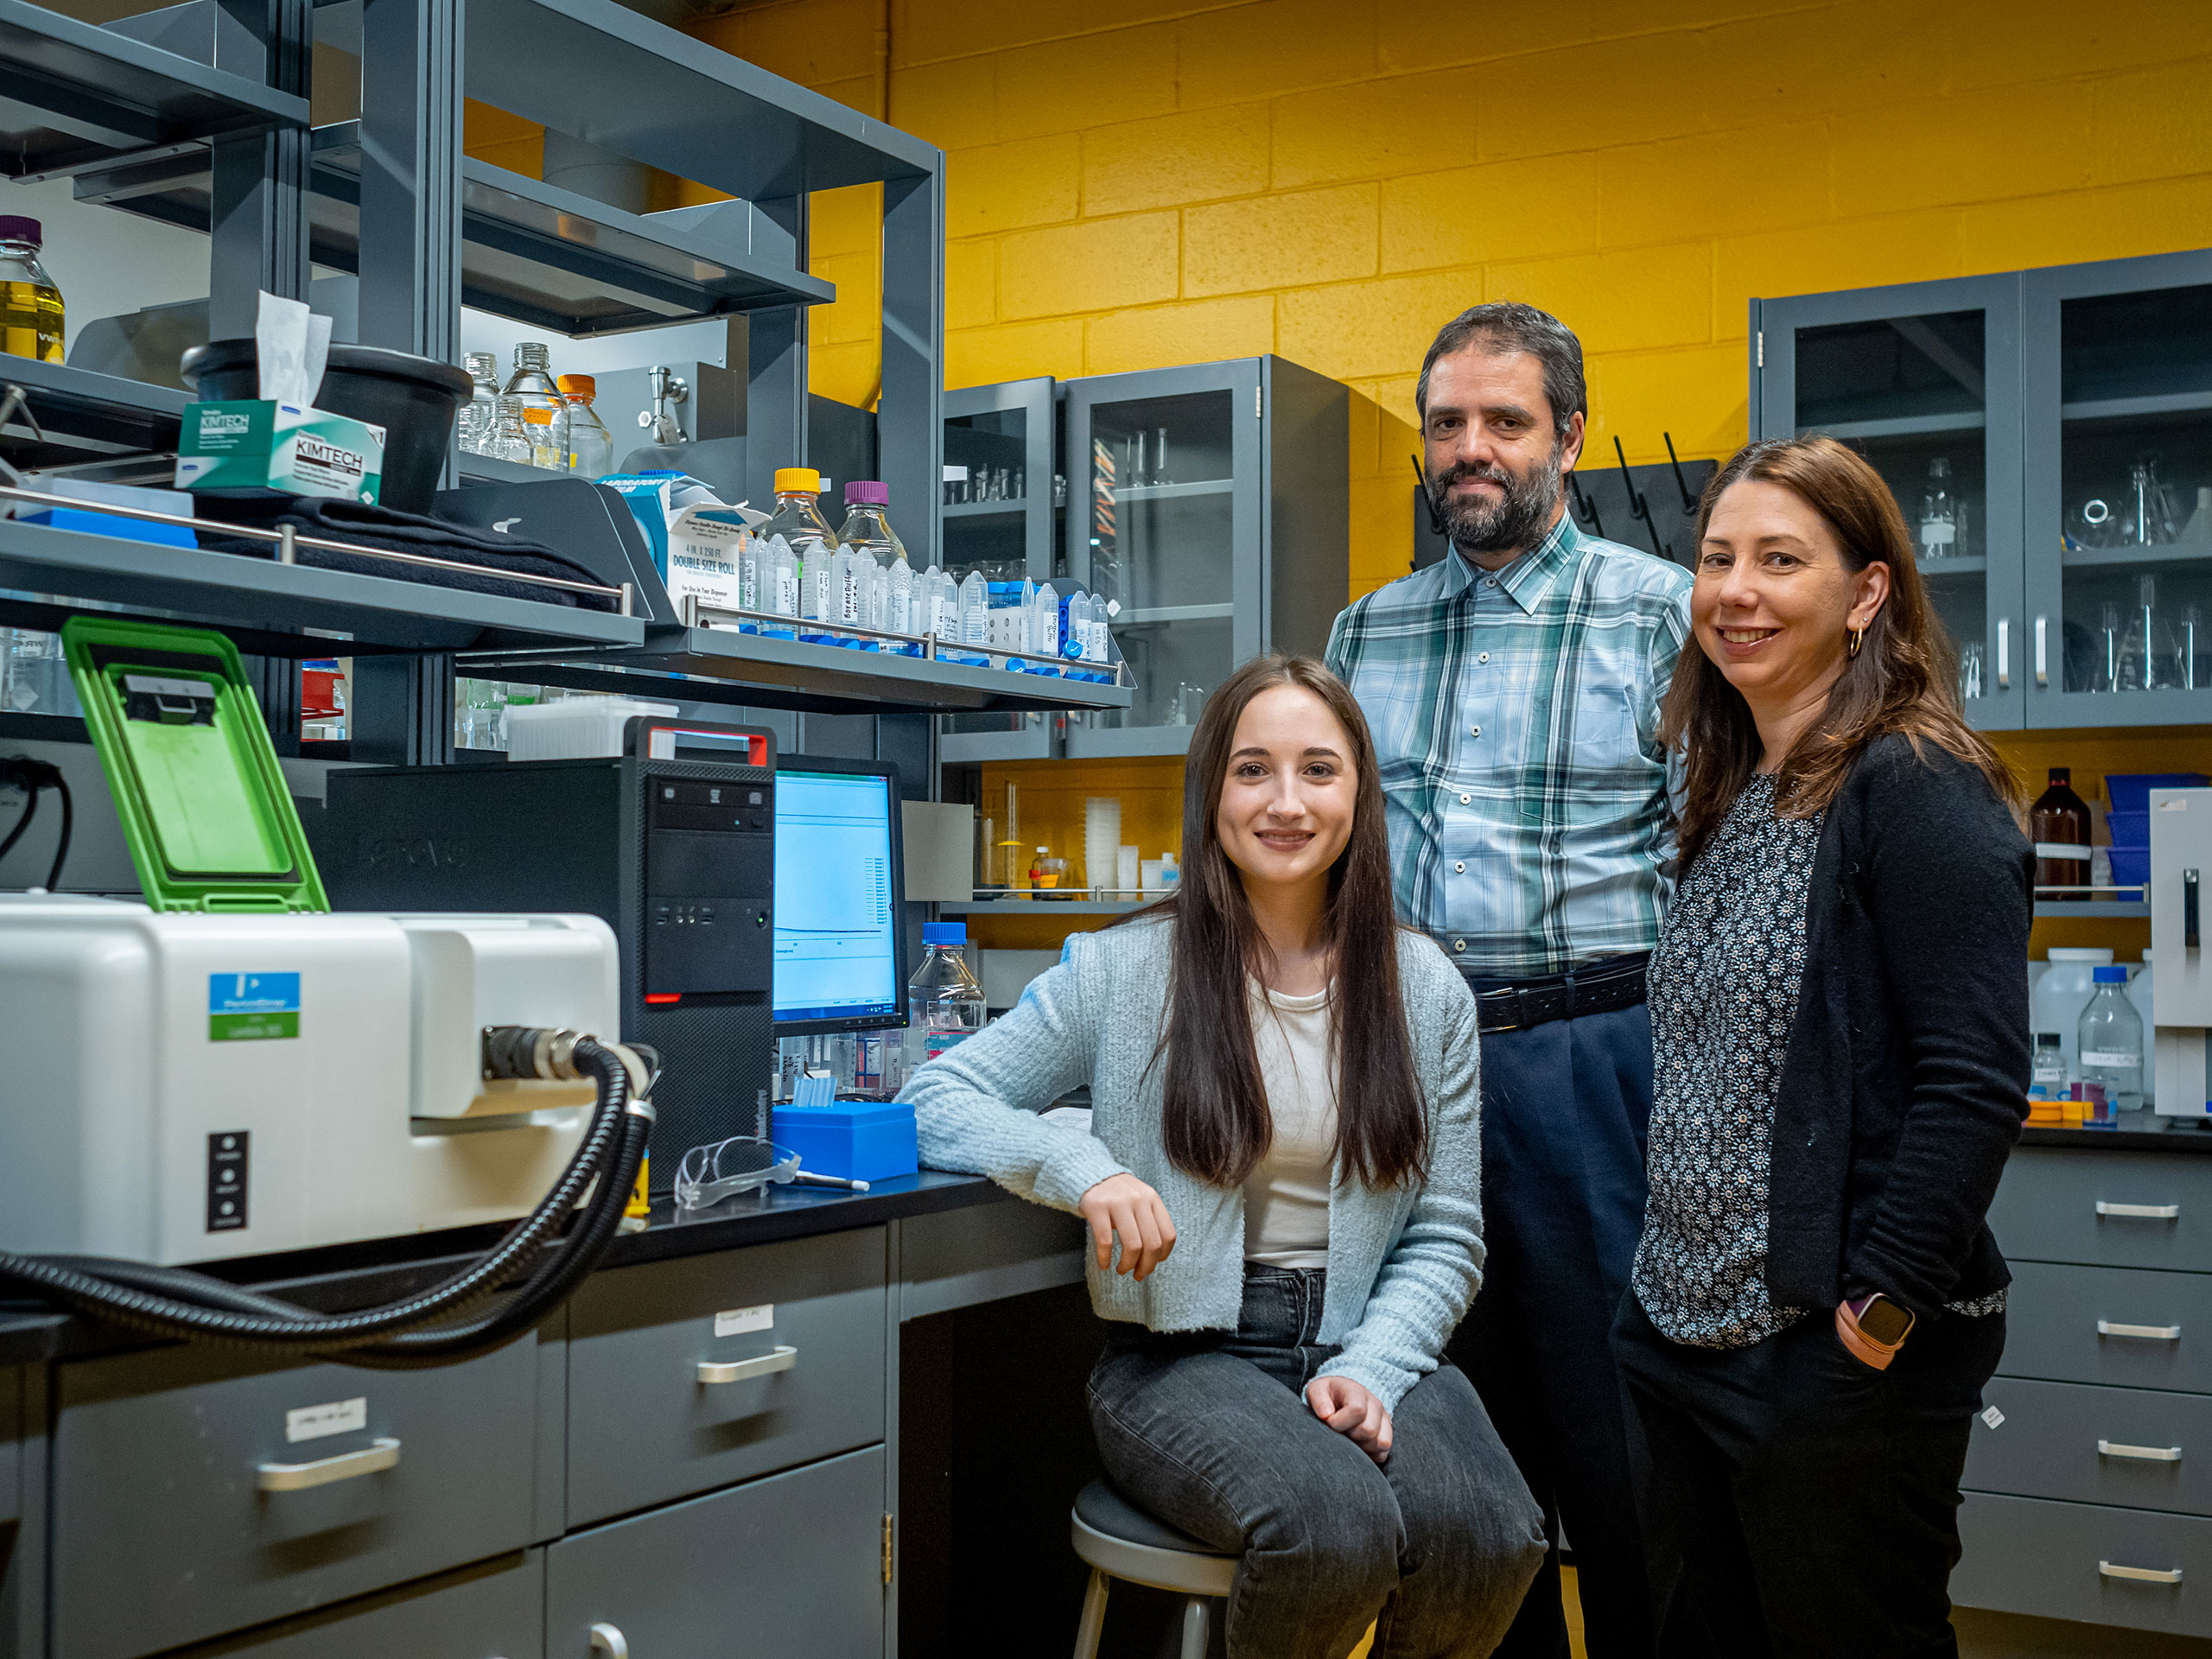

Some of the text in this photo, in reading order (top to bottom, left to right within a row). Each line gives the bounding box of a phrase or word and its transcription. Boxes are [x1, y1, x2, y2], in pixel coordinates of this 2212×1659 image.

[200, 414, 250, 429] KIMTECH
[296, 439, 363, 469] KIMTECH
[673, 554, 701, 570] DOUBLE
[702, 558, 717, 573] SIZE
[718, 561, 735, 575] ROLL
